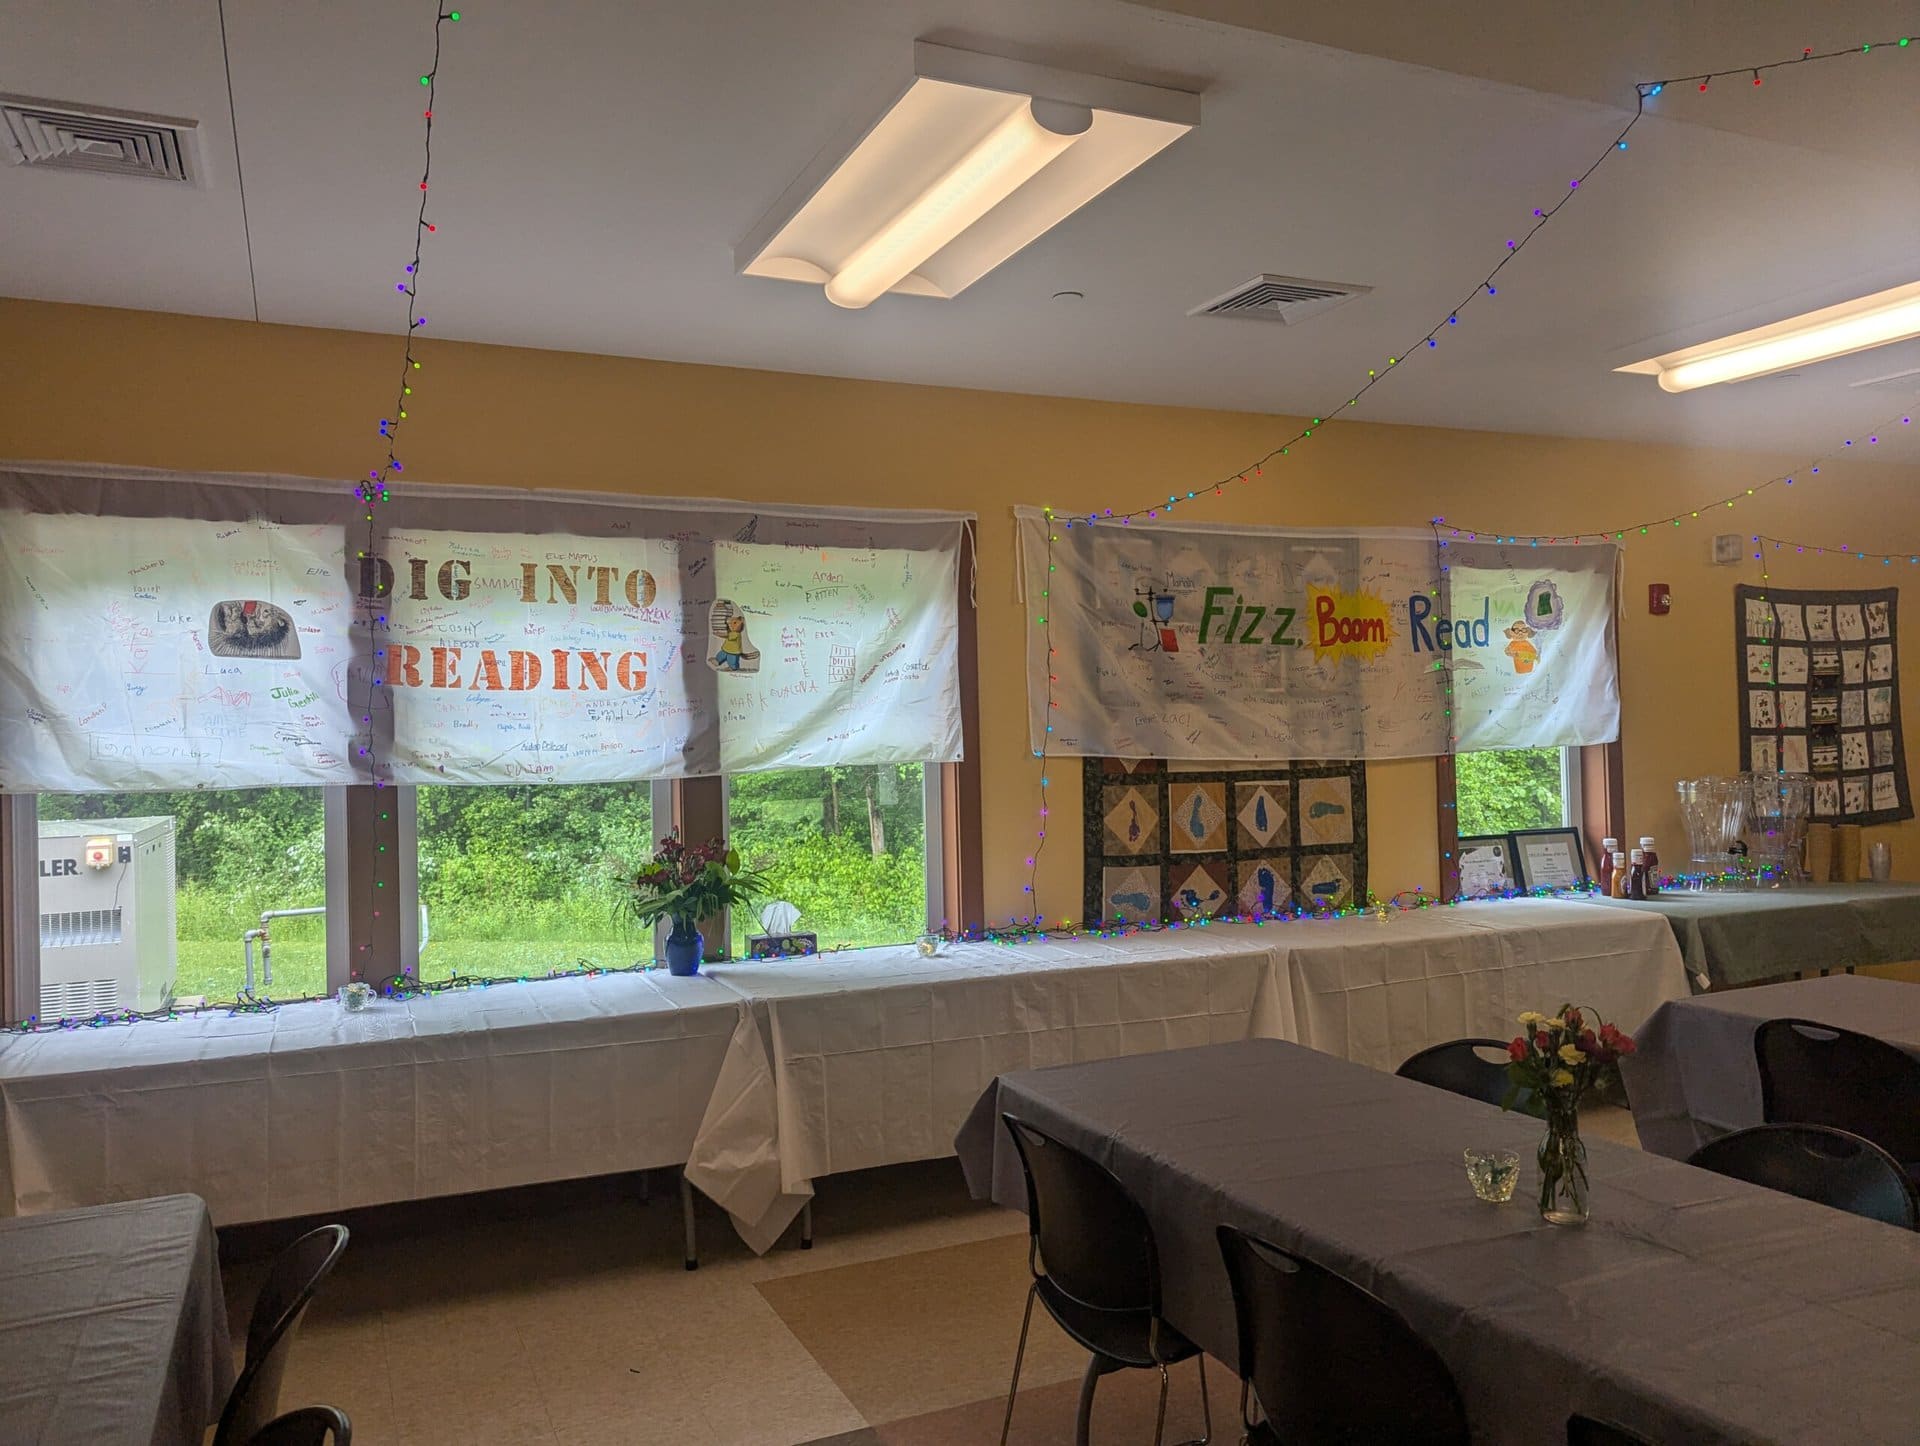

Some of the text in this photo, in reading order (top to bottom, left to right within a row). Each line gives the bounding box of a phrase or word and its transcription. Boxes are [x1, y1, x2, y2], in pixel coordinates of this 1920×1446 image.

[358, 557, 472, 600] DIG
[520, 562, 656, 608] INTO
[157, 610, 193, 624] Luke
[1409, 594, 1489, 653] Read
[204, 664, 242, 676] Luca
[385, 644, 648, 692] READING
[270, 686, 301, 700] Julia
